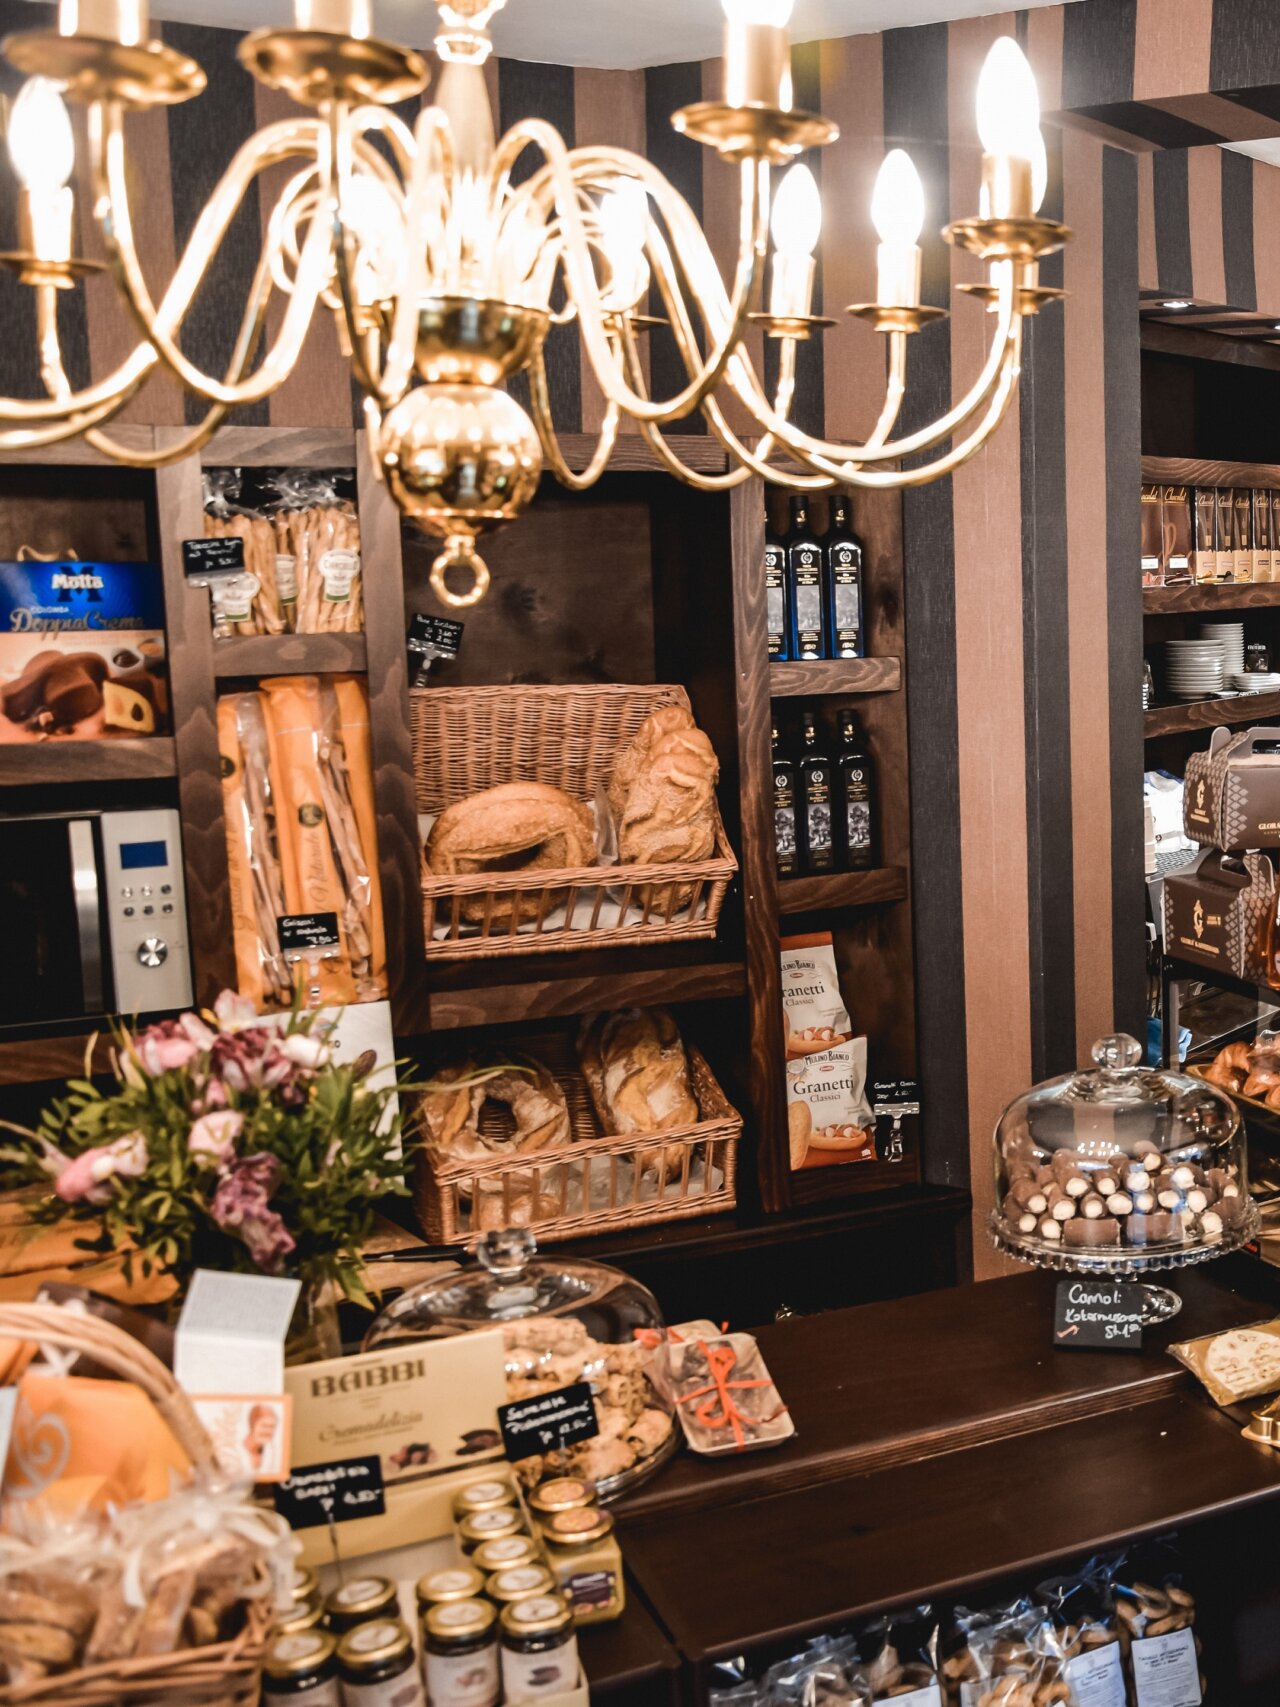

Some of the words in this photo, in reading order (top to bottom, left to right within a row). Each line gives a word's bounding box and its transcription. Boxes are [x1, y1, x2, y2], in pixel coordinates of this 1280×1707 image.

[1164, 486, 1187, 504] Chocolat
[51, 573, 104, 590] Motta
[783, 982, 825, 998] ranetti
[786, 998, 815, 1008] Classici
[805, 1053, 828, 1065] MULINO
[828, 1051, 850, 1062] BIANCO
[793, 1075, 854, 1095] Granetti
[809, 1094, 841, 1104] Classici
[311, 1360, 426, 1398] BABBI
[319, 1411, 424, 1443] Cremadelizia
